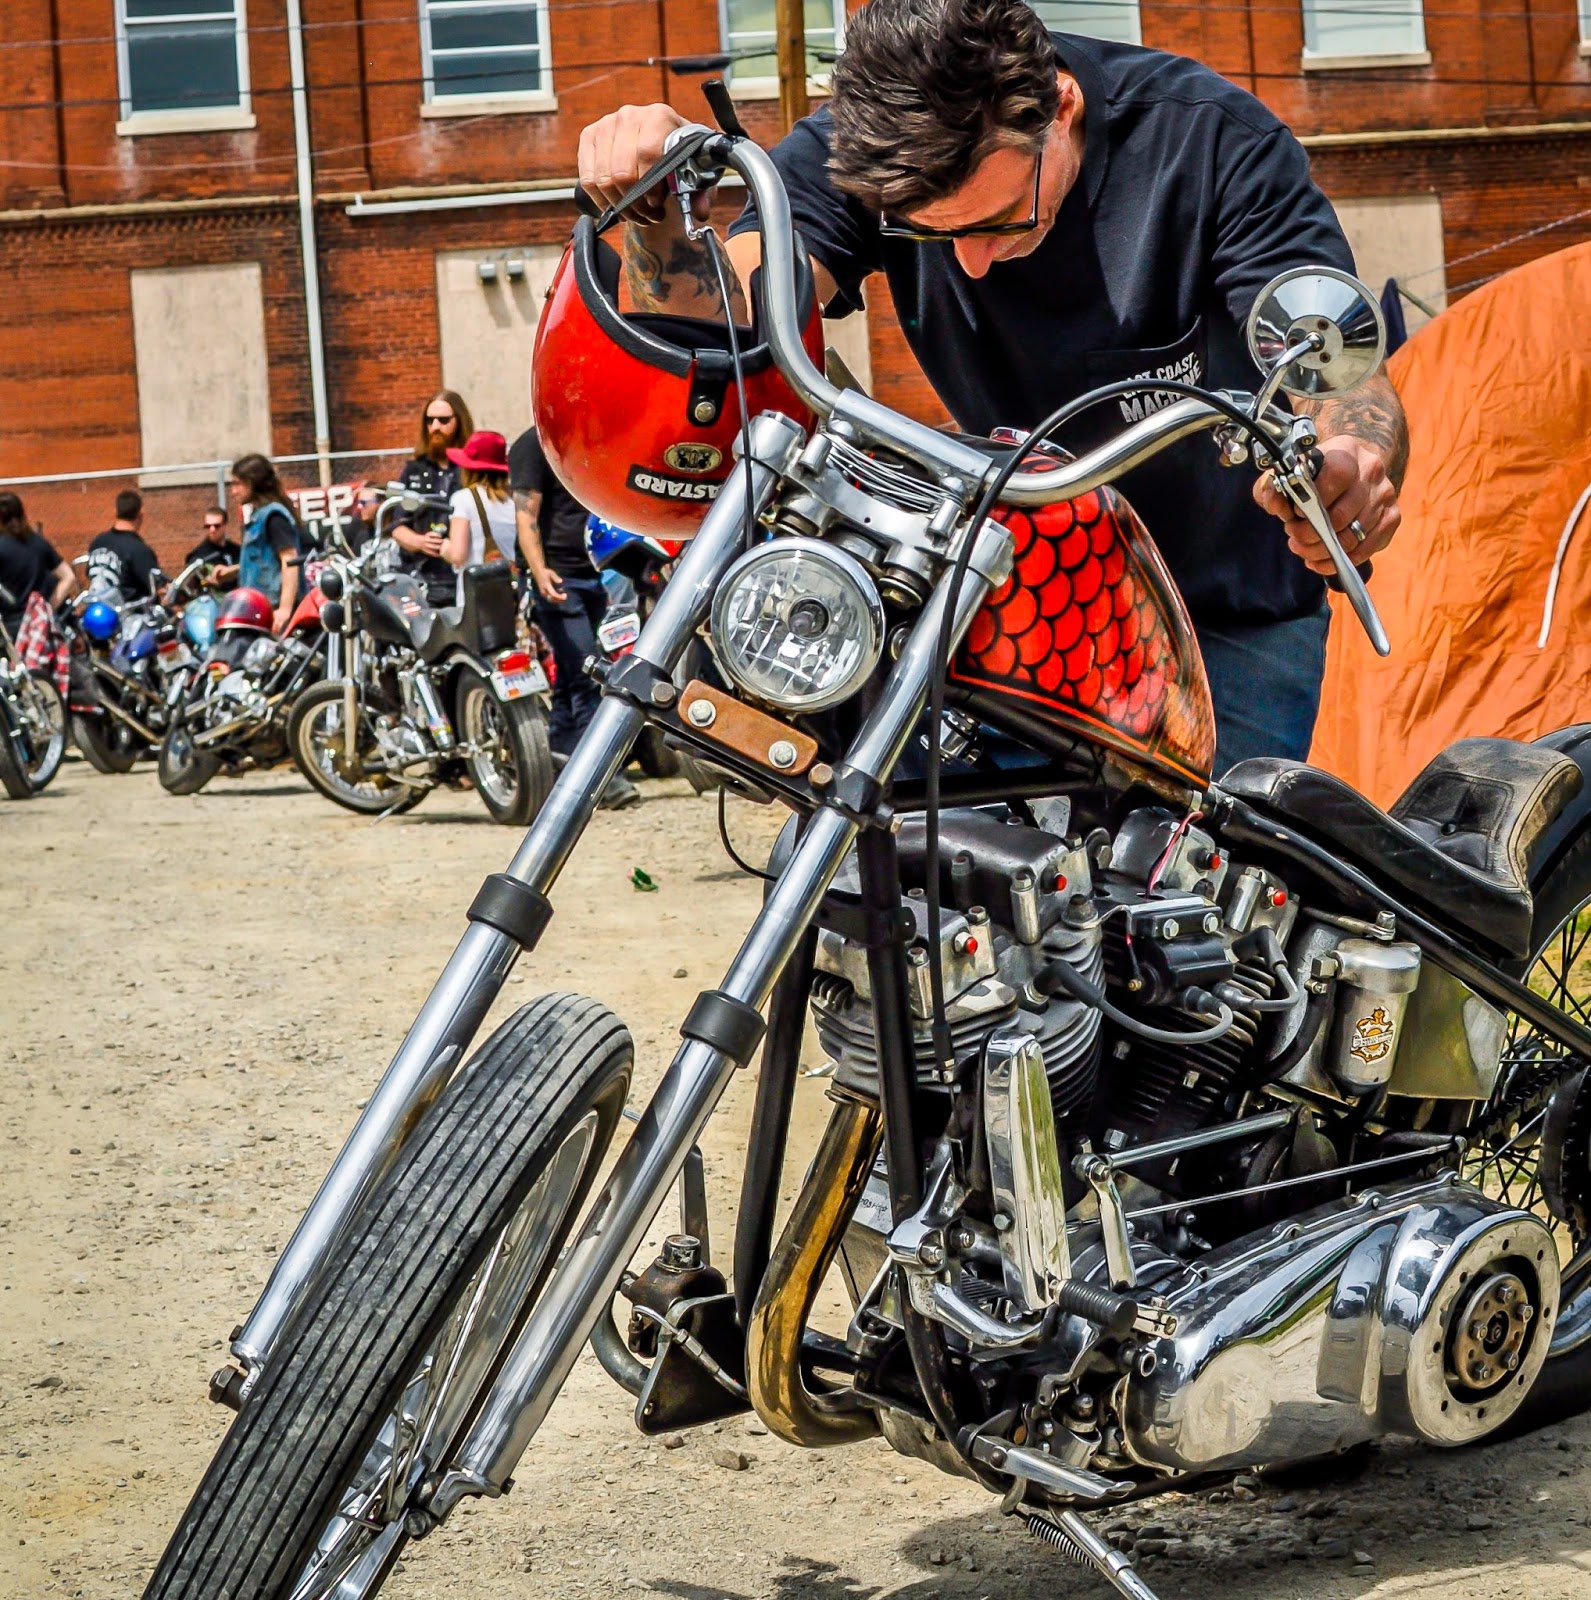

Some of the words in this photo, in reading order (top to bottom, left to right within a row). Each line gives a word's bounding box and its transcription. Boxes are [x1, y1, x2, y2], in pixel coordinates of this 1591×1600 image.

[1156, 352, 1195, 382] COAST
[1119, 360, 1202, 423] MACNE
[634, 473, 721, 499] ASTARD
[288, 486, 354, 522] EP
